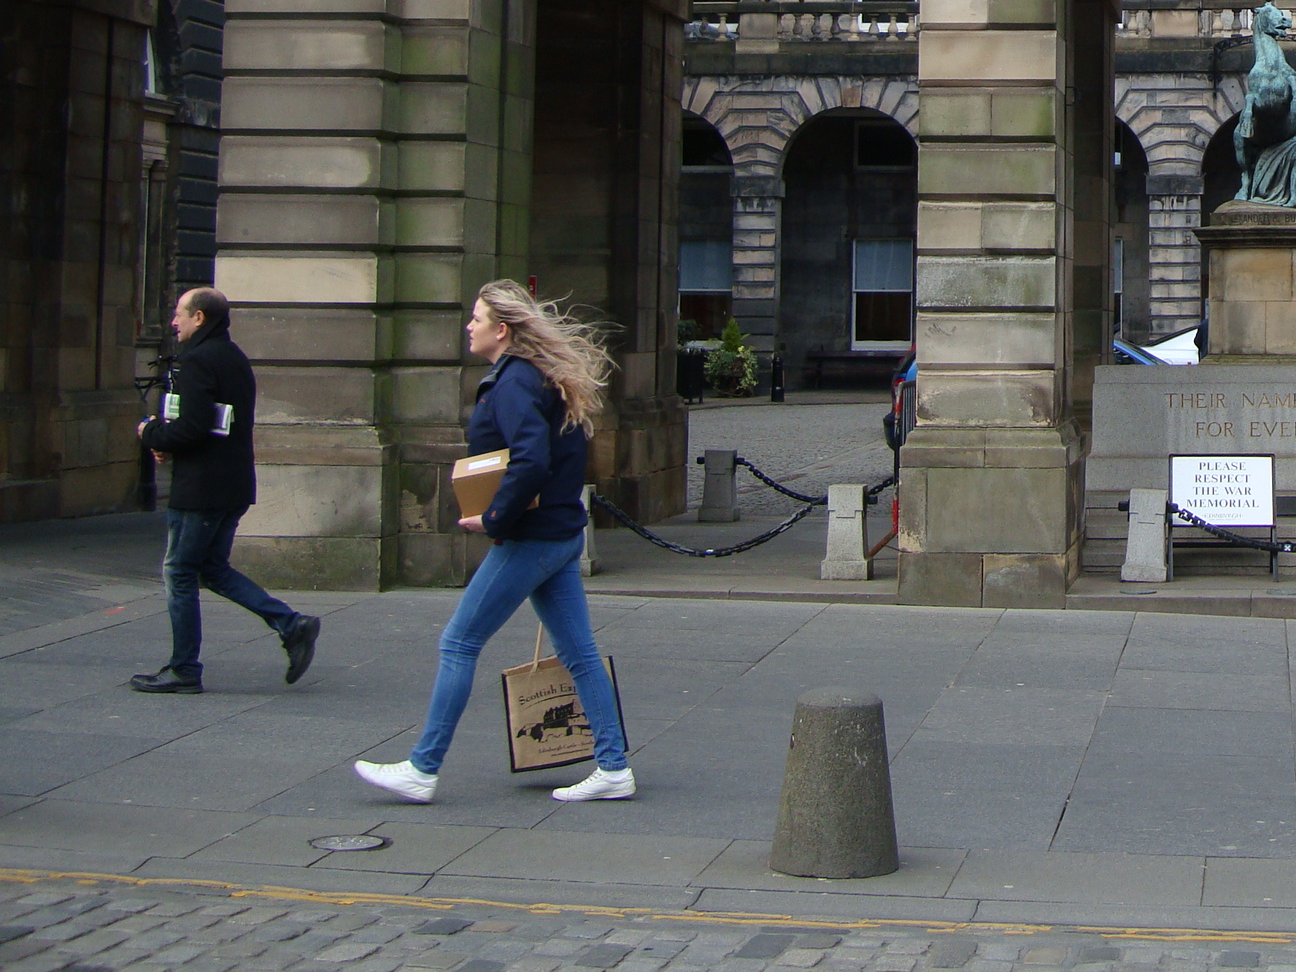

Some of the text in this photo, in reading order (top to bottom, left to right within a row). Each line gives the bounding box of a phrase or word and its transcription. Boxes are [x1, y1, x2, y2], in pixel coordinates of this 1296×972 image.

[1224, 213, 1270, 224] LEXANDER
[1164, 392, 1227, 409] THEIR
[1196, 421, 1236, 438] FOR
[1199, 461, 1247, 471] PLEASE
[1194, 474, 1251, 483] RESPECT
[1192, 486, 1252, 496] THE WAR
[1186, 498, 1260, 508] MEMORIAL
[518, 684, 557, 705] Scottish
